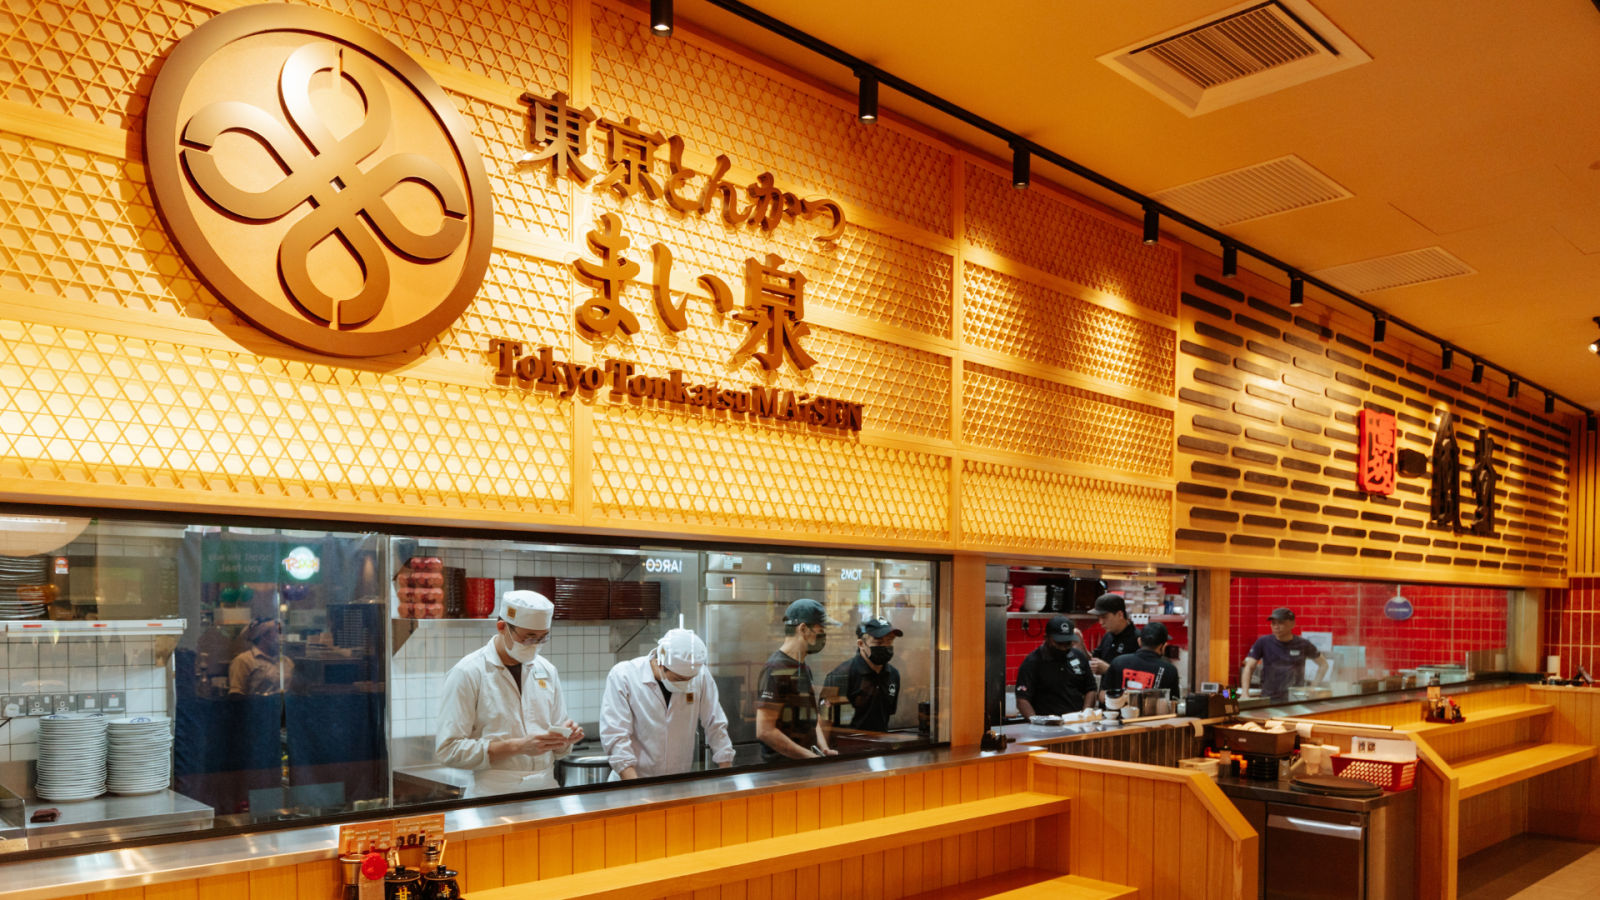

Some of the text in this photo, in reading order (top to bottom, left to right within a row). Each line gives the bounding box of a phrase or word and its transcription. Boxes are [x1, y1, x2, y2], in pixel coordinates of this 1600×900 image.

[517, 91, 845, 246] 東京とんかつ
[572, 212, 818, 373] まい泉
[489, 338, 604, 397] Tokyo
[604, 359, 751, 413] Tonkatsu
